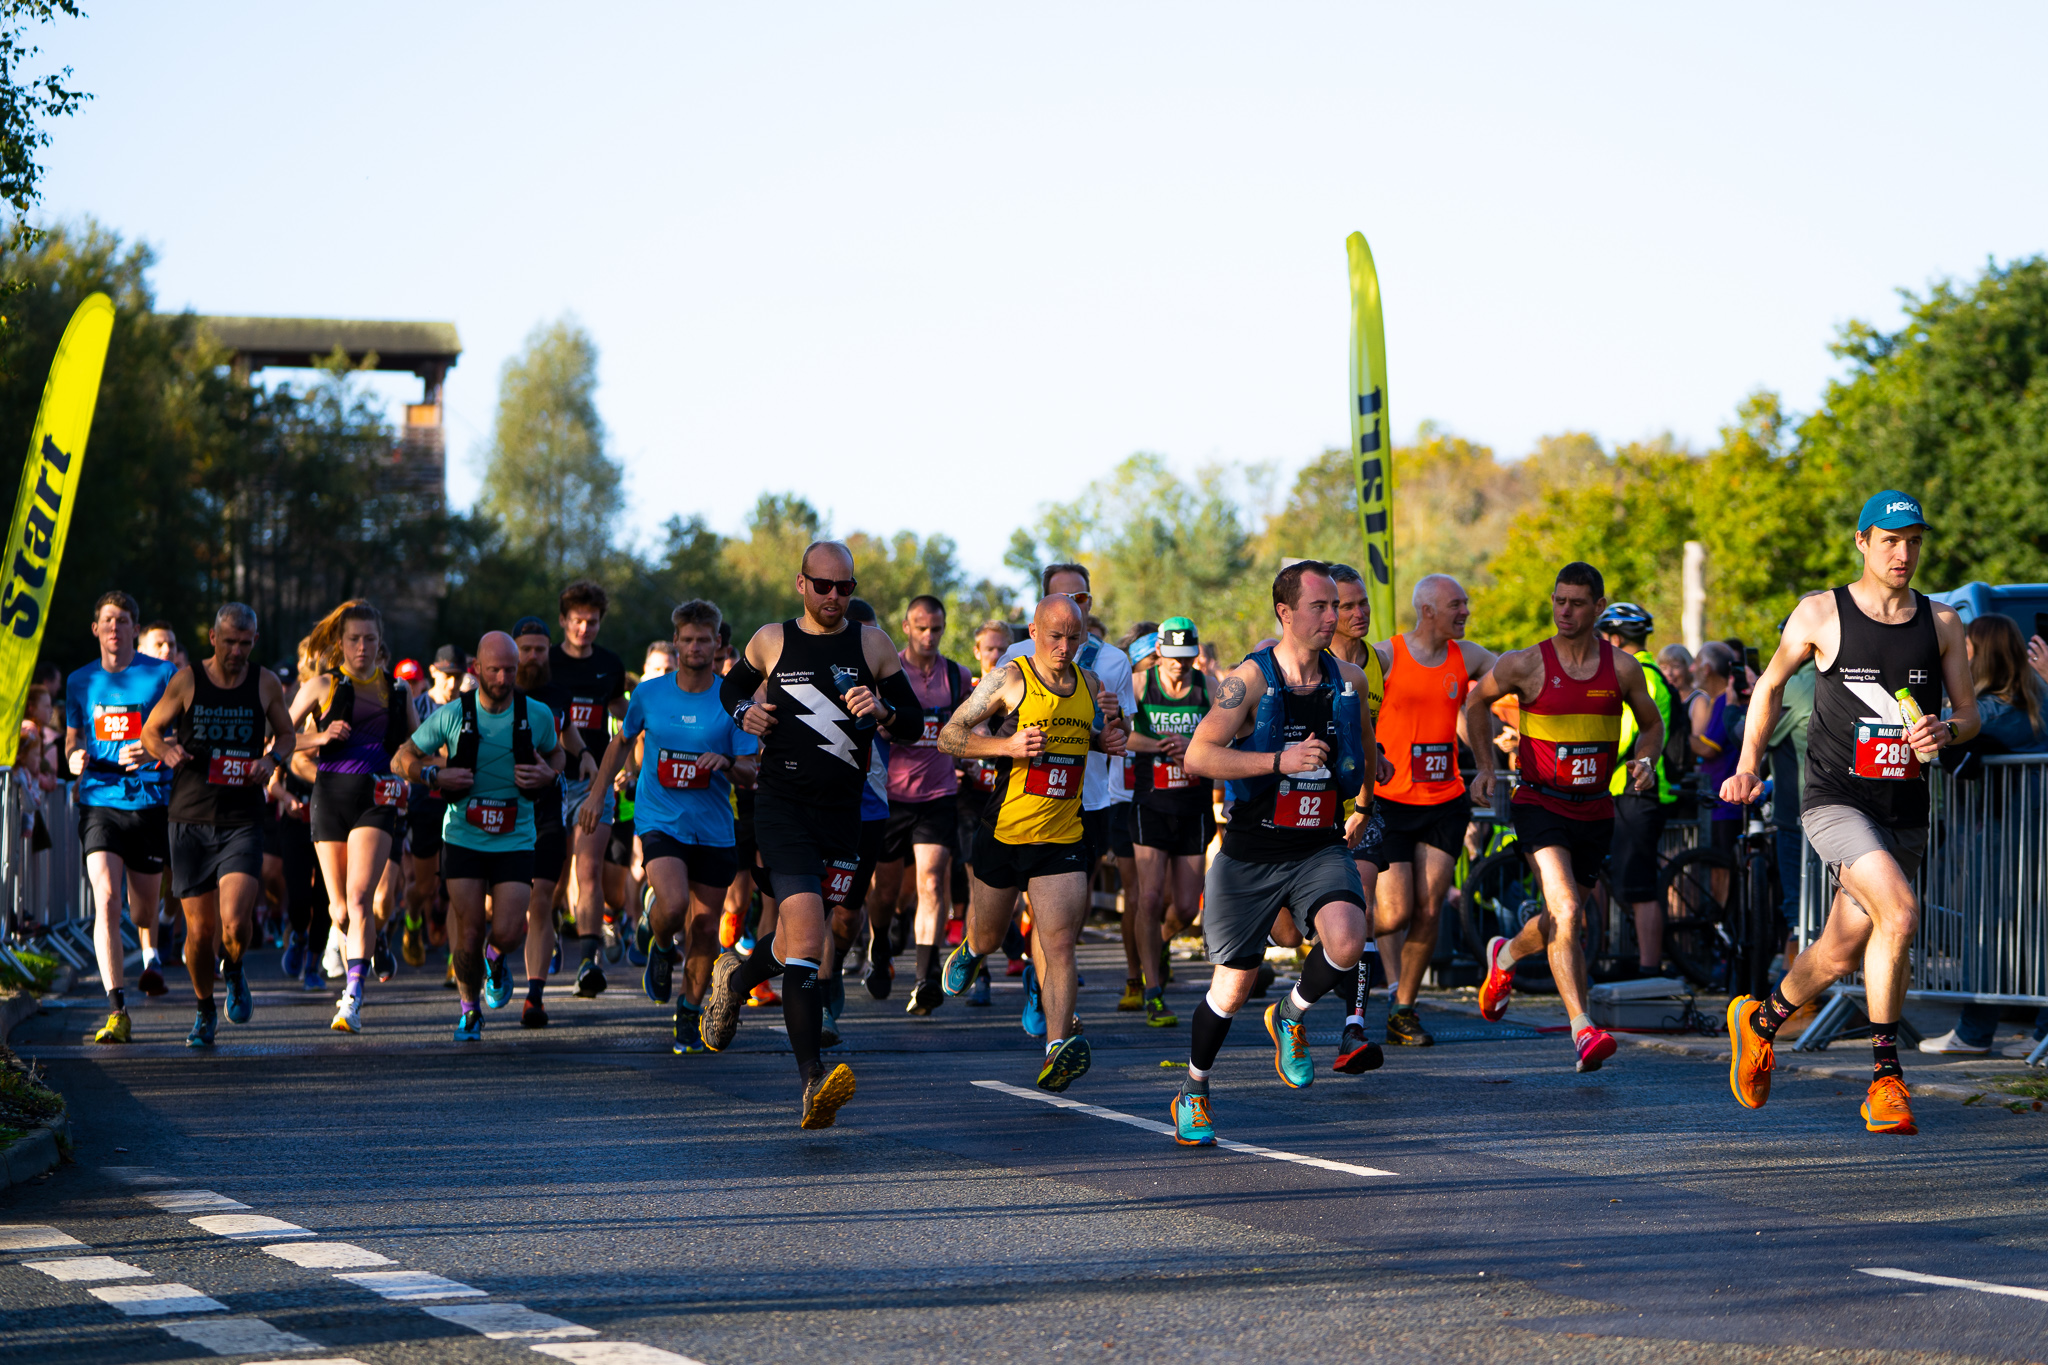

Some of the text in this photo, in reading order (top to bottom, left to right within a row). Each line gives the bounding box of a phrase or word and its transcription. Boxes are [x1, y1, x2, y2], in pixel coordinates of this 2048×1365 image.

[1886, 502, 1920, 515] HOKA
[1, 433, 71, 639] Start
[194, 704, 254, 717] Bodmin
[572, 706, 592, 720] 177
[1149, 711, 1202, 725] VEGAN
[193, 724, 254, 744] 2019
[1149, 724, 1196, 733] RUNNER
[1877, 728, 1903, 737] MARATH
[1047, 735, 1084, 745] ARRIERS
[1047, 755, 1075, 765] MARATHON
[1874, 743, 1911, 765] 289
[1425, 756, 1448, 771] 279
[1571, 758, 1597, 776] 214
[671, 763, 697, 779] 179
[1048, 768, 1067, 787] 64
[1166, 766, 1187, 780] 19
[1881, 766, 1906, 777] MARC
[1046, 787, 1066, 797] SIMON
[1296, 781, 1327, 791] MARATHON
[1298, 796, 1321, 816] 82
[481, 809, 504, 825] 154
[1296, 817, 1321, 827] JAMES
[830, 873, 853, 893] 46
[827, 893, 847, 903] ANDY
